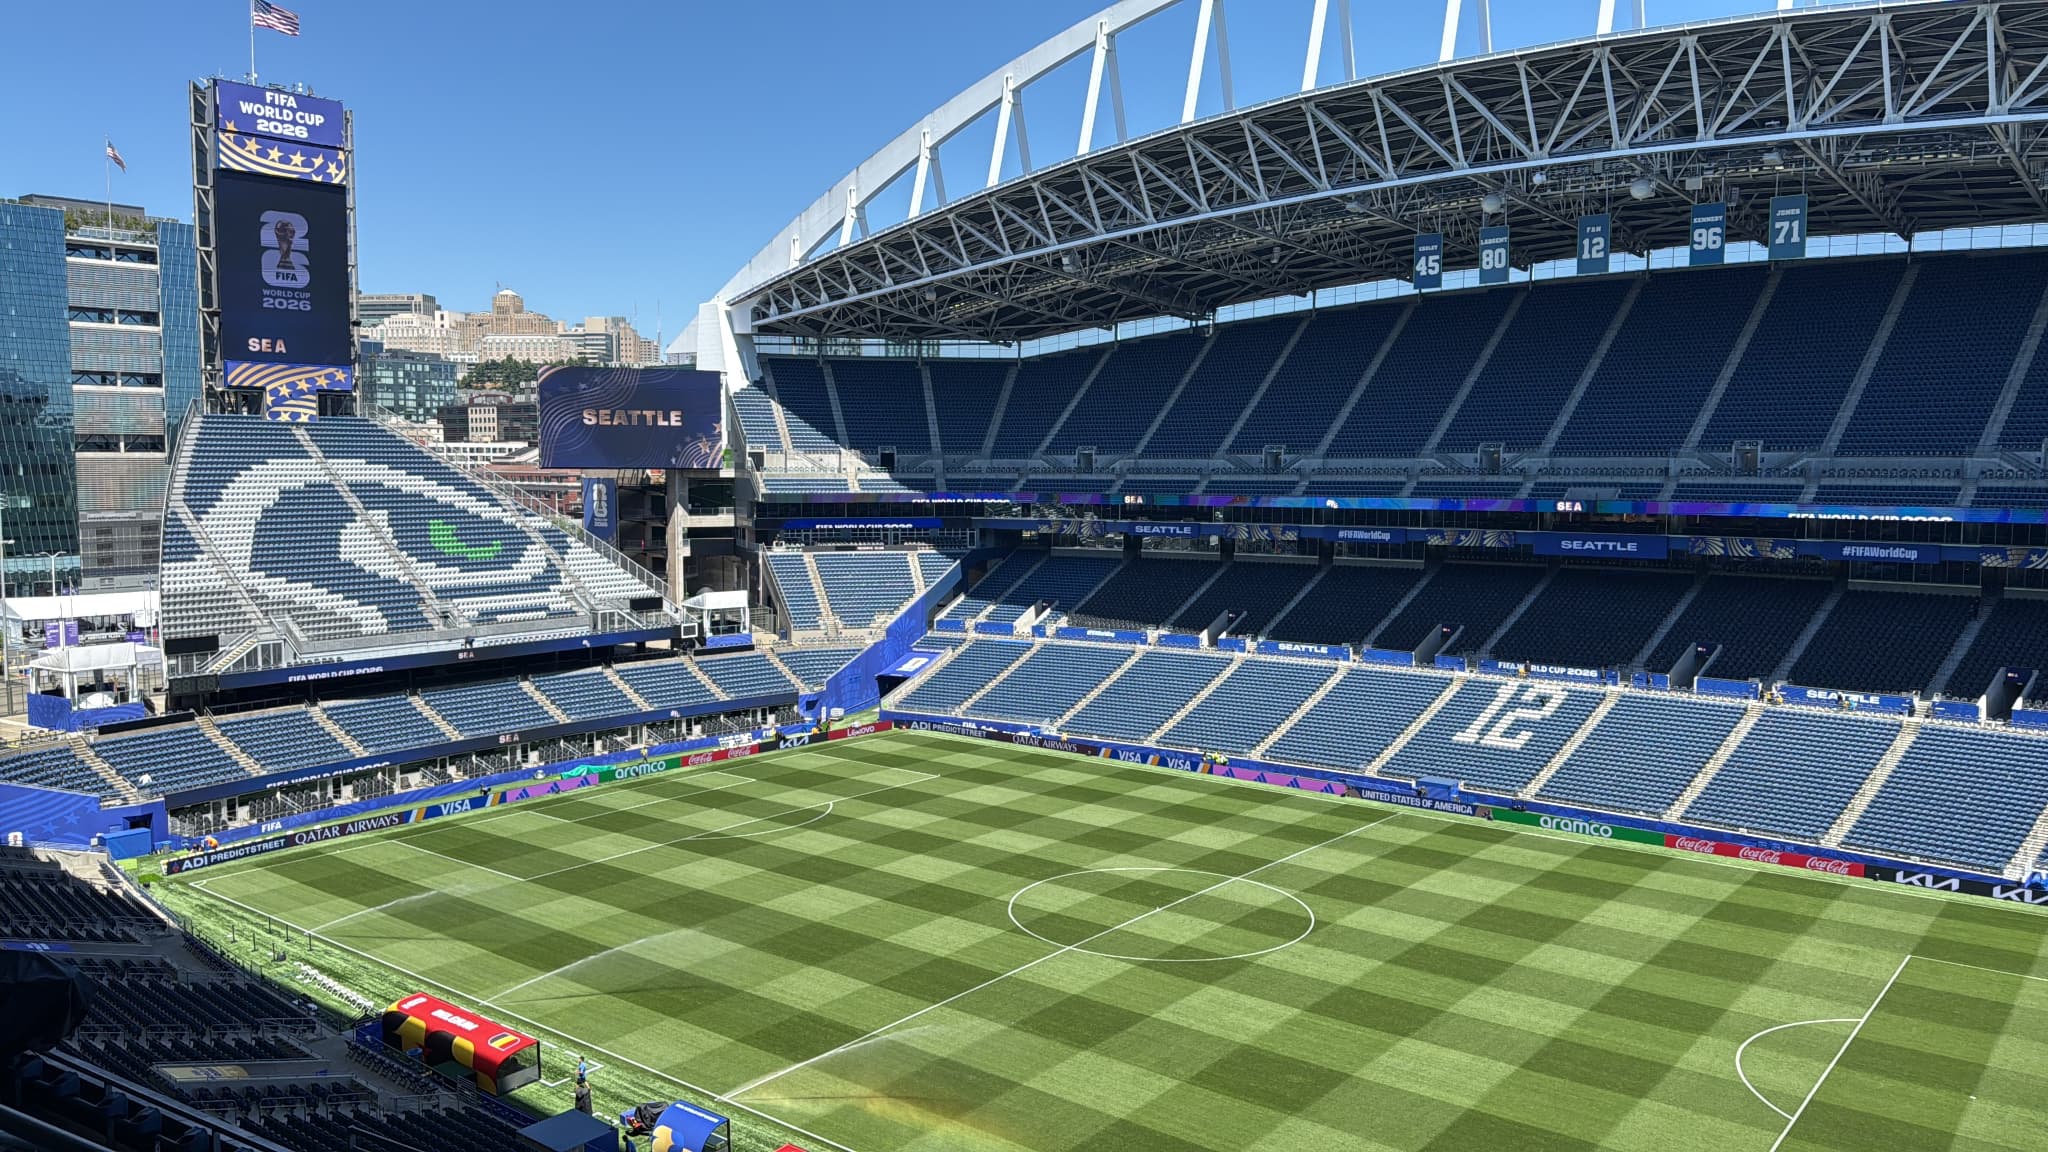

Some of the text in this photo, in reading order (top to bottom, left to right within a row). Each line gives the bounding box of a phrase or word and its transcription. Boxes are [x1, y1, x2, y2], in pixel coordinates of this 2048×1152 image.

[266, 91, 297, 108] FIFA
[240, 101, 324, 126] WORLD CUP
[256, 119, 308, 138] 2026
[1692, 227, 1722, 250] 96
[1774, 220, 1800, 244] 71
[1582, 237, 1604, 259] 12
[1416, 255, 1440, 276] 45
[1482, 248, 1506, 270] 80
[276, 271, 297, 282] FIFA
[262, 289, 293, 298] WORLD
[263, 298, 311, 311] 2026
[248, 338, 287, 353] SEA
[583, 408, 682, 426] SEATTLE
[1124, 495, 1143, 504] SEA
[1557, 502, 1582, 512] SEA
[1135, 525, 1192, 534] SEATTLE
[1338, 530, 1390, 541] #FIFAWorldCup
[1561, 540, 1638, 552] SEATTLE
[1843, 546, 1918, 559] #FIFAWorldCup
[1278, 643, 1328, 654] SEATTLE
[1549, 666, 1566, 674] CUP
[1567, 668, 1598, 677] 2026
[1452, 682, 1568, 749] 12
[911, 721, 931, 730] ADI
[933, 724, 987, 738] PREDICTSTREET
[499, 734, 520, 744] SEA
[780, 736, 809, 749] KIA
[1013, 735, 1078, 753] QATAR AIRWAYS
[1119, 750, 1141, 763] VISA
[1167, 758, 1192, 771] VISA
[615, 760, 666, 779] aramco
[441, 799, 472, 816] VISA
[1361, 789, 1473, 814] UNITED STATES OF AMERICA
[261, 822, 282, 834] FIFA
[295, 815, 400, 845] QATAR AIRWAYS
[1539, 816, 1612, 838] aramco
[182, 838, 286, 871] ADI PREDICTSTREET
[1896, 870, 1959, 891] KIA
